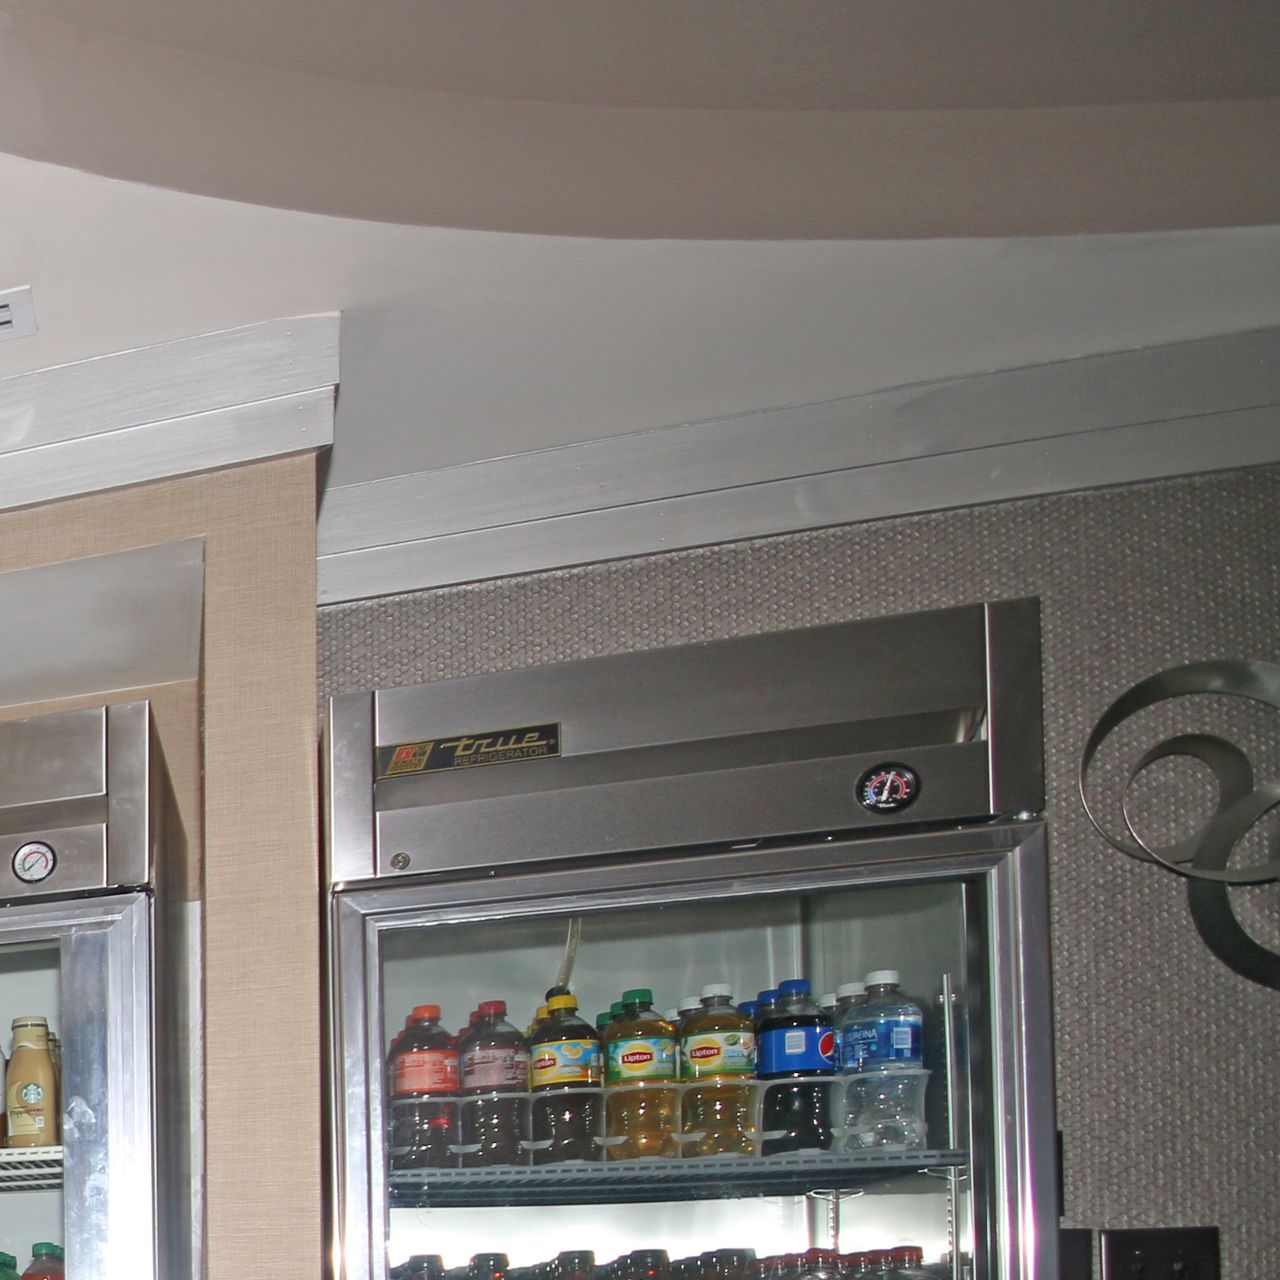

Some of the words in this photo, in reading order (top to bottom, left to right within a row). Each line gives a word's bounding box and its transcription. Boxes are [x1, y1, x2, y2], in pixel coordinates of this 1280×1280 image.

[441, 732, 547, 757] true
[454, 745, 548, 767] REFRIGERATOR
[622, 1052, 651, 1063] Lipton
[691, 1047, 719, 1058] Lipton
